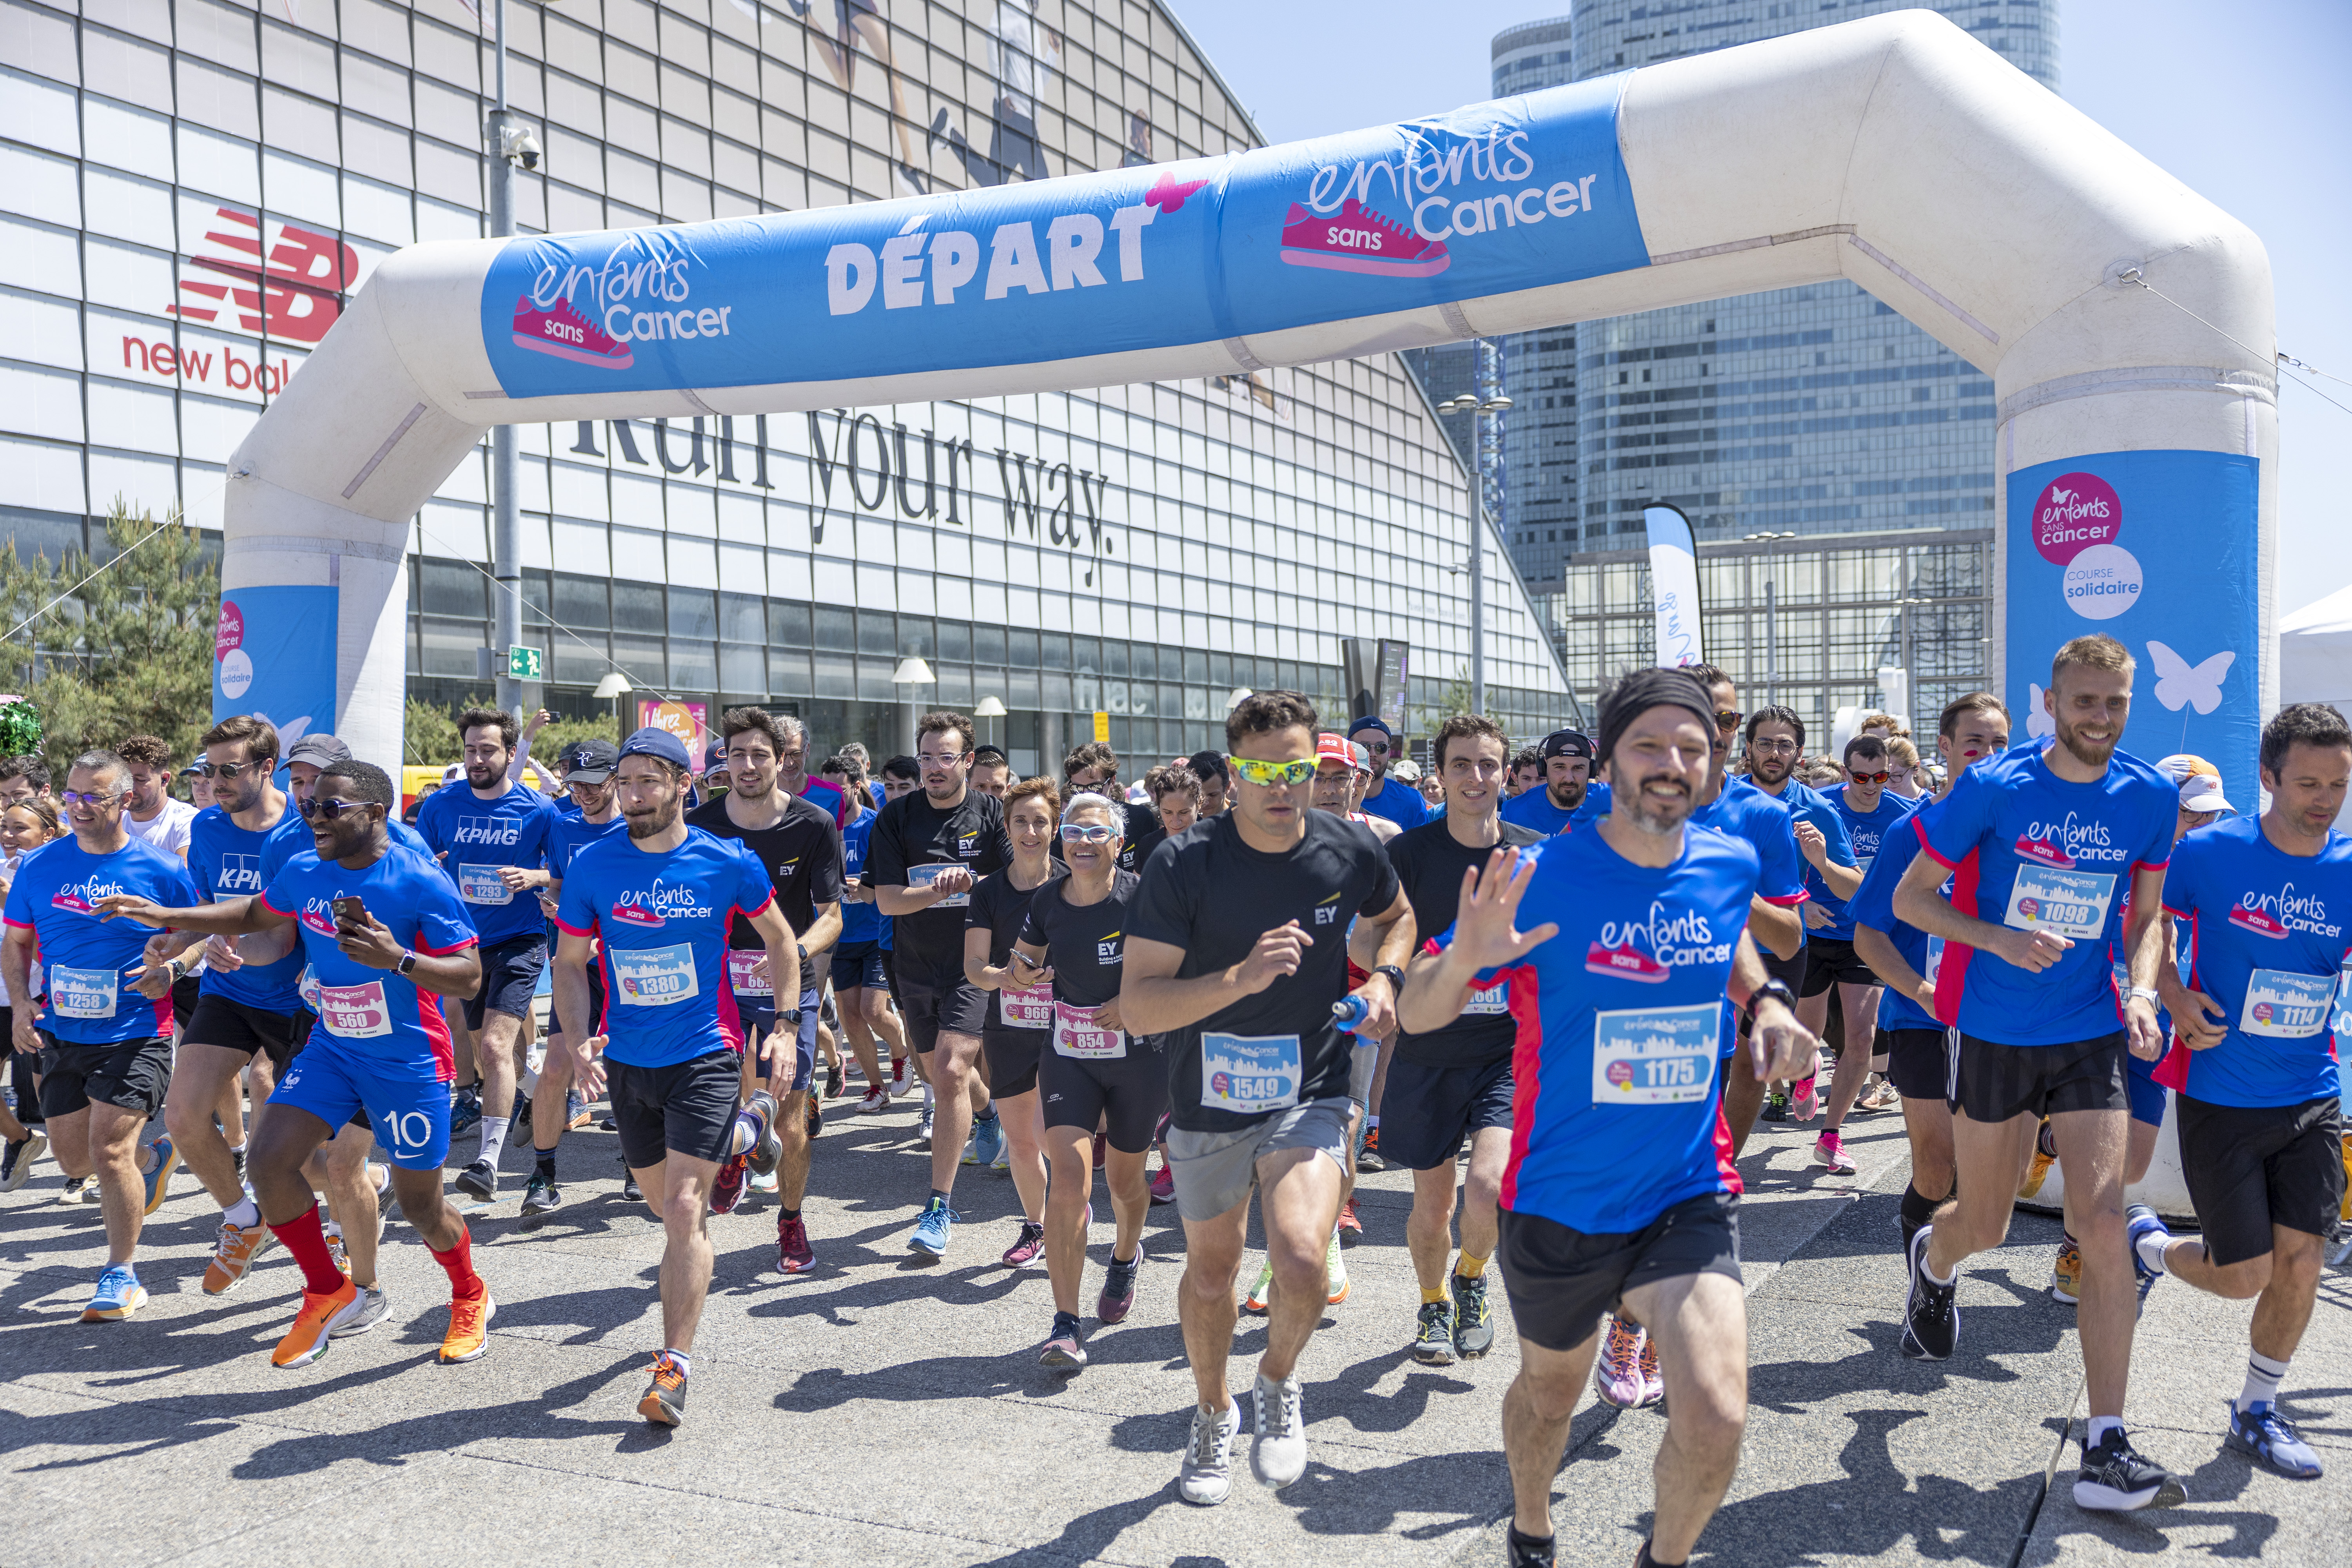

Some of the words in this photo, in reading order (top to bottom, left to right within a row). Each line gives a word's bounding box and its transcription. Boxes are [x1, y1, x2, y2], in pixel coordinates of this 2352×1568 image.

[1301, 122, 1534, 212] enfants
[1413, 174, 1596, 241] Cancer
[1327, 226, 1382, 250] sans
[824, 203, 1160, 316] DÉPART
[528, 238, 689, 314] enfants
[544, 318, 584, 343] sans
[604, 304, 731, 343] Cancer
[122, 336, 212, 382] new
[808, 408, 972, 544] your
[995, 447, 1112, 587] way.
[2042, 493, 2110, 524] enfants
[2042, 522, 2064, 534] SANS
[2042, 523, 2110, 546] cancer
[2067, 568, 2114, 581] COURSE
[2067, 580, 2140, 598] solidaire
[217, 636, 239, 648] cancer
[221, 665, 240, 673] COURSE
[221, 673, 250, 684] solidaire
[454, 826, 519, 846] KPMG
[1848, 825, 1880, 845] fants
[2026, 811, 2111, 847] enfants
[959, 839, 975, 850] EY
[1854, 842, 1879, 853] Canc
[2033, 844, 2054, 857] sans
[2065, 843, 2128, 861] Cancer
[1123, 851, 1134, 862] EY
[780, 865, 795, 875] EY
[2039, 871, 2063, 883] enfants
[2075, 878, 2098, 886] Cancer
[59, 875, 124, 900] enfants
[476, 886, 501, 898] 1293
[618, 878, 695, 909] enfants
[2240, 882, 2326, 921] enfants
[626, 910, 645, 919] sans
[655, 905, 713, 918] Cancer
[1314, 905, 1337, 925] EY
[2045, 902, 2089, 924] 1098
[309, 916, 324, 928] sans
[1599, 900, 1712, 952] enfants
[2248, 915, 2270, 928] sans
[2281, 914, 2342, 938] Cancer
[625, 953, 643, 961] enfants
[1098, 942, 1117, 956] EY
[1655, 942, 1731, 967] Cancer
[1610, 953, 1641, 969] sans
[640, 975, 680, 994] 1380
[748, 975, 769, 988] 66
[2272, 975, 2296, 986] enfants
[2308, 982, 2329, 990] Cancer
[68, 993, 100, 1008] 1258
[336, 1013, 368, 1028] 560
[1024, 1006, 1049, 1020] 966
[1065, 1009, 1078, 1017] enfants
[2283, 1007, 2317, 1025] 1114
[1077, 1033, 1105, 1048] 854
[1644, 1058, 1695, 1086] 1175
[1232, 1077, 1279, 1099] 1549
[383, 1110, 431, 1148] 10
